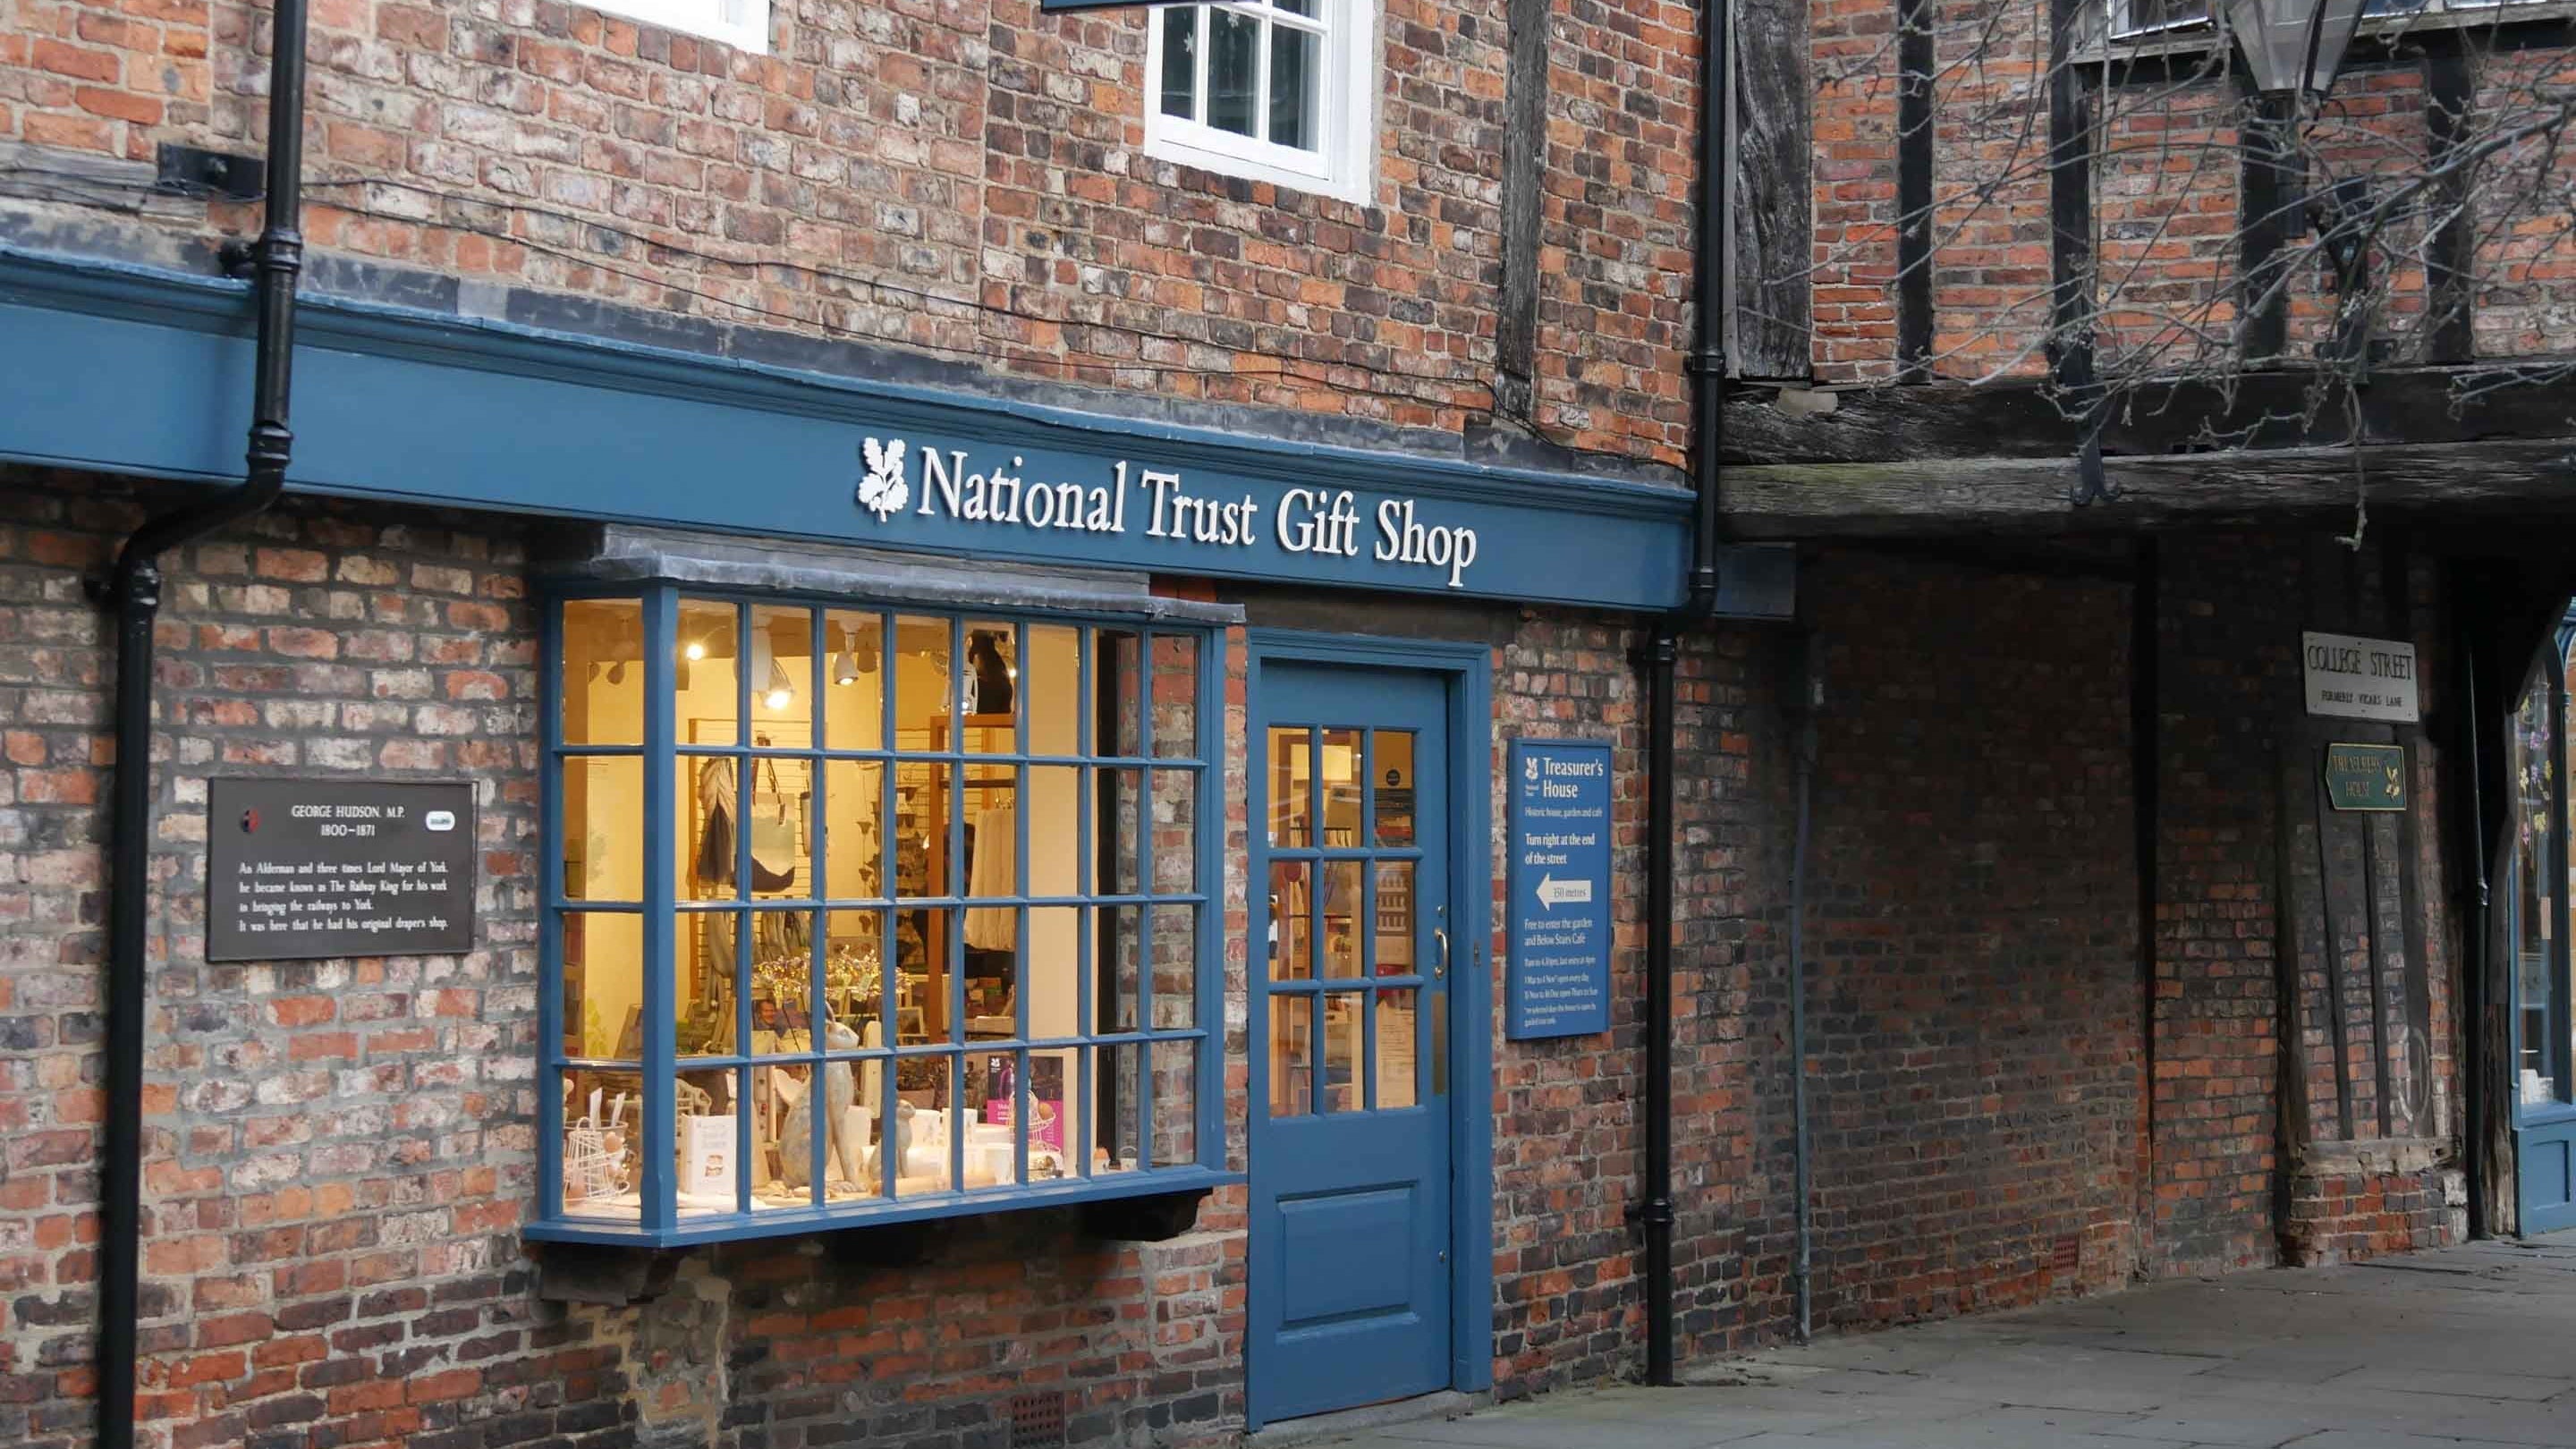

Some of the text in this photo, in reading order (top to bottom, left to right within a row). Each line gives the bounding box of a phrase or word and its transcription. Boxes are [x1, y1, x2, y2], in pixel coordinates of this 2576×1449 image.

[917, 446, 1478, 589] National Trust Gift Shop
[2307, 645, 2413, 681] COLLEGE STREET
[2385, 695, 2402, 708] LANE
[1543, 757, 1604, 777] Treasurer's
[1543, 779, 1579, 798] House
[292, 805, 333, 818] GEORGE
[1525, 833, 1596, 849] Turn right at the end
[1524, 852, 1568, 865] of the street
[239, 861, 252, 874] An
[257, 861, 295, 874] Alderman
[298, 861, 313, 874] and
[317, 861, 338, 874] three
[342, 863, 363, 873] times
[367, 861, 386, 873] Lord
[390, 861, 414, 877] Mayor
[417, 861, 428, 873] of
[239, 878, 447, 895] he became known as The Railway King for his work
[1564, 887, 1587, 899] metres
[290, 899, 303, 911] the
[307, 899, 338, 915] railways
[342, 901, 352, 911] to
[239, 919, 247, 932] It
[250, 923, 266, 931] was
[269, 919, 288, 931] here
[292, 919, 309, 930] that
[312, 919, 324, 930] he
[327, 917, 343, 930] had
[345, 917, 359, 929] his
[360, 917, 392, 933] original
